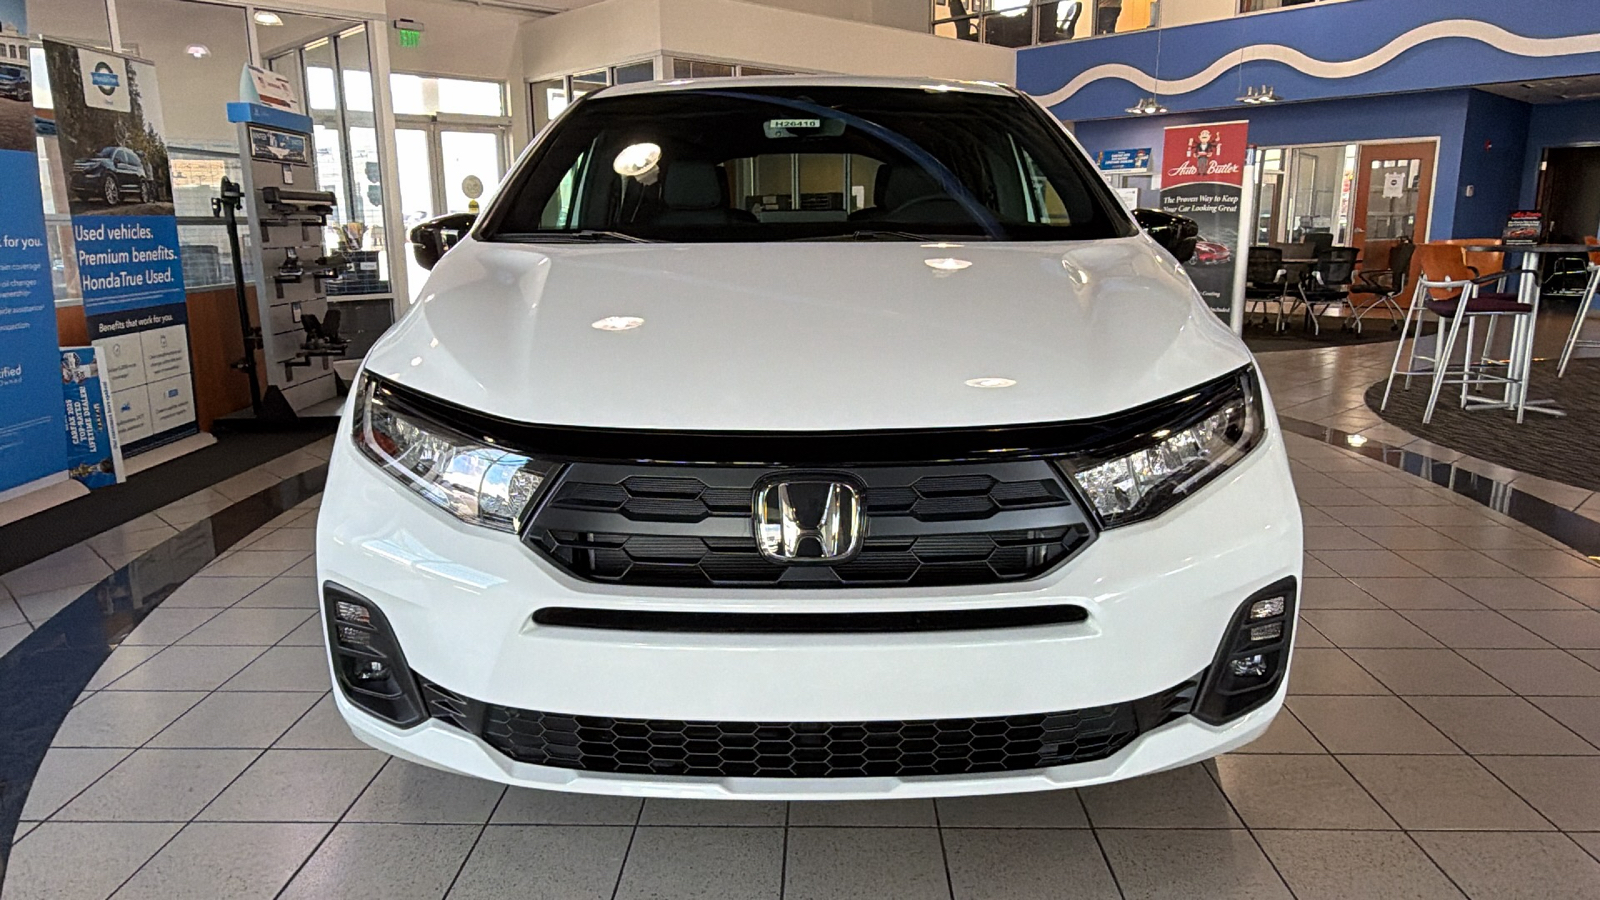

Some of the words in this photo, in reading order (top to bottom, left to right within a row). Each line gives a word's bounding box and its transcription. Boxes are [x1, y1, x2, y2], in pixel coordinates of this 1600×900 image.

[1167, 160, 1197, 176] Auto
[1207, 160, 1239, 174] Butler
[1163, 196, 1175, 204] The
[1176, 195, 1199, 204] Proven
[1200, 194, 1213, 204] Way
[1214, 195, 1221, 203] to
[1222, 194, 1239, 204] Keep
[1178, 205, 1191, 213] Car
[1191, 204, 1217, 213] Looking
[1218, 204, 1238, 212] Great
[74, 223, 105, 241] Used
[107, 223, 154, 240] vehicles.
[4, 234, 19, 248] for
[21, 238, 44, 251] you.
[78, 248, 129, 266] Premium
[132, 244, 178, 262] benefits.
[82, 271, 143, 291] HondaTrue
[145, 266, 175, 284] Used.
[99, 319, 125, 333] Benefits
[125, 318, 138, 328] that
[138, 315, 153, 326] work
[153, 314, 161, 323] for
[162, 314, 174, 324] you.
[68, 416, 79, 445] CARFAX
[74, 401, 88, 442] TOP-RATED
[84, 417, 97, 453] LIFETIME
